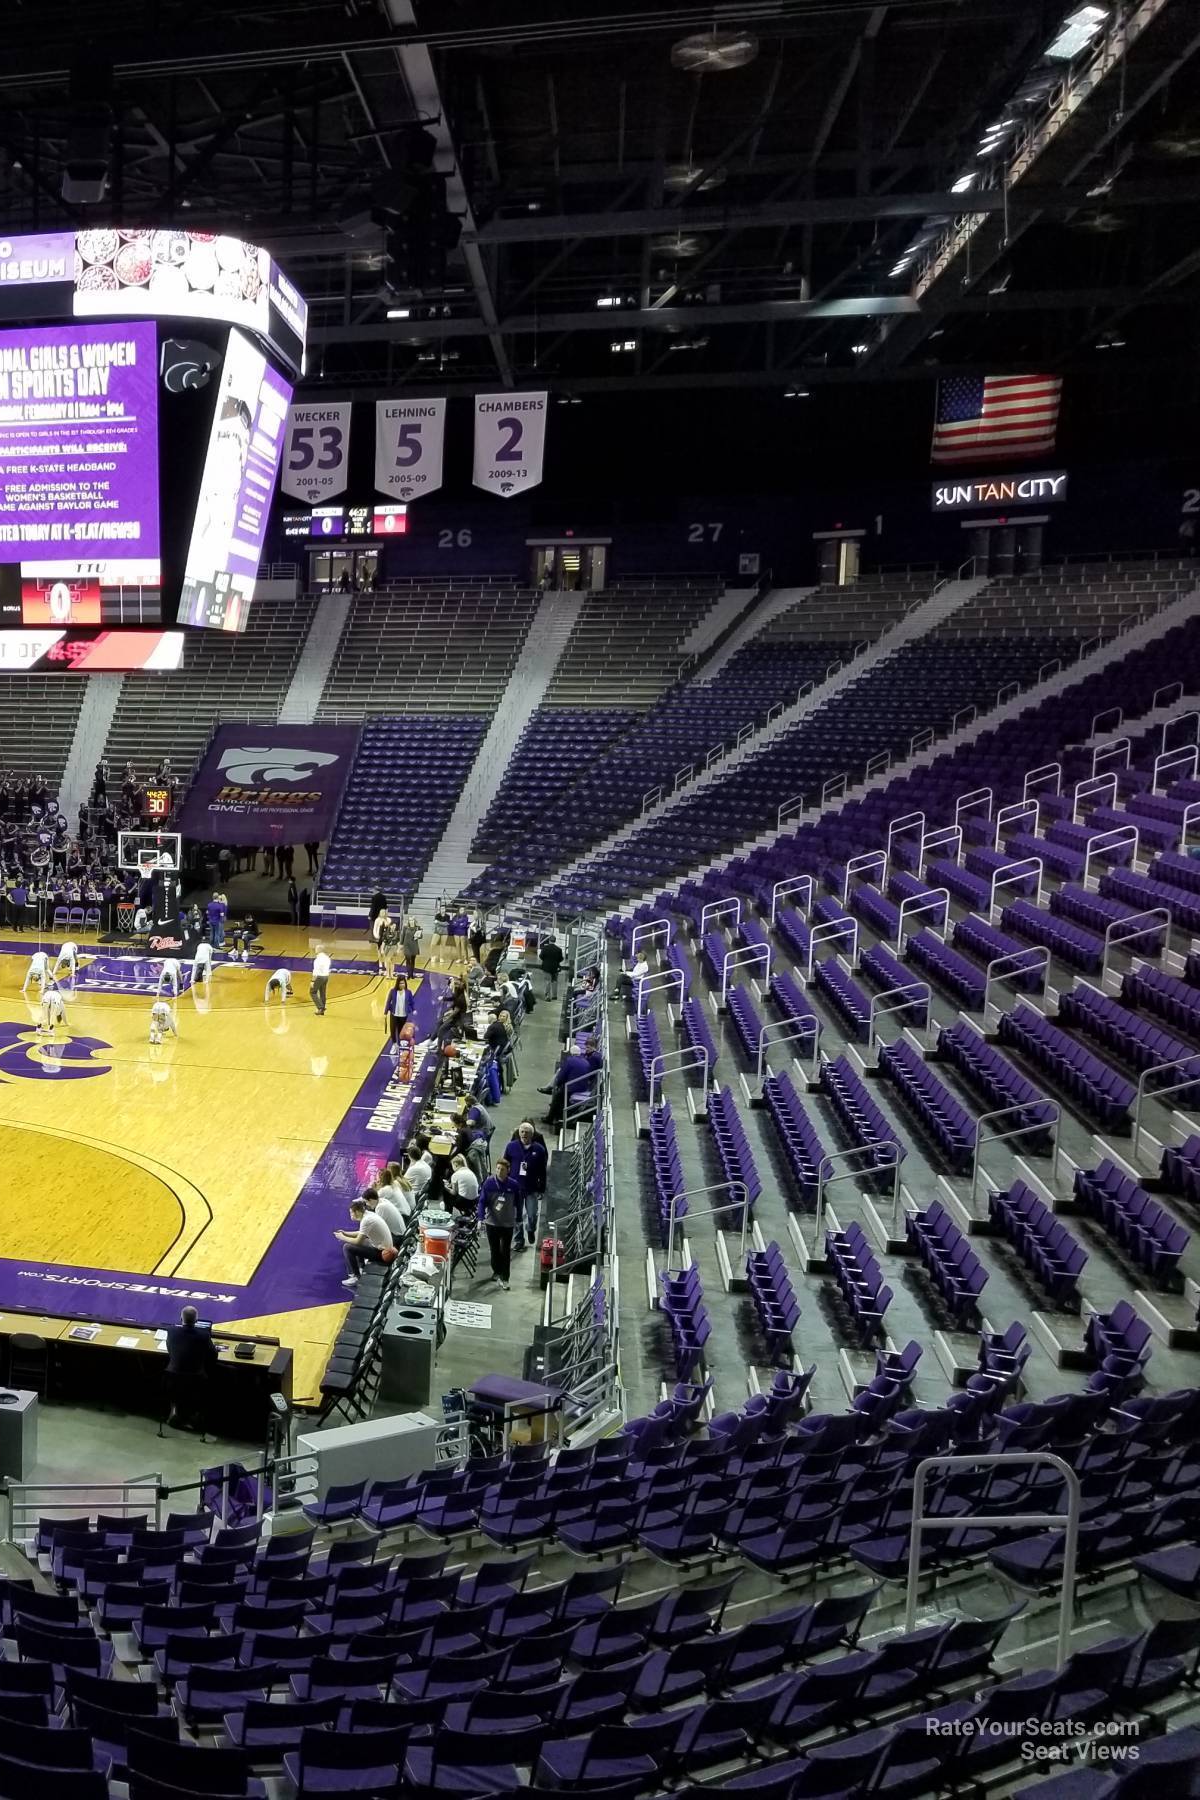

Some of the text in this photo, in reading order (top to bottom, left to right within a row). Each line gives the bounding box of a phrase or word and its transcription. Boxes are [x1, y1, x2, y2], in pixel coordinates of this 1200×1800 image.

[30, 345, 68, 371] GIRLS
[70, 344, 81, 369] &
[81, 340, 137, 368] WOMEN
[11, 368, 75, 400] SPORTS
[77, 366, 111, 397] DAY
[385, 407, 437, 418] LEHNING
[478, 400, 544, 413] CHAMBERS
[294, 412, 340, 423] WECKER
[395, 424, 423, 467] 5
[495, 417, 523, 462] 2
[288, 427, 343, 470] 53
[6, 465, 28, 474] FREE
[30, 464, 66, 473] K-STATE
[67, 462, 117, 472] HEADBAND
[488, 469, 528, 479] 2009-13
[296, 477, 334, 486] 2001-05
[388, 474, 427, 483] 2005-09
[5, 482, 110, 493] FREE ADMISSION TO THE
[935, 475, 1066, 505] SUN TAN CITY
[5, 492, 103, 502] WOMEN'S BASKETBALL
[18, 502, 55, 511] AGAINST
[57, 502, 92, 510] BAYLOR
[94, 501, 119, 509] GAME
[438, 529, 472, 548] 26
[688, 523, 723, 542] 27
[49, 582, 71, 619] 0
[146, 791, 168, 799] 44:22
[218, 786, 322, 805] Briggs
[149, 800, 164, 813] 30
[208, 804, 246, 813] GMC
